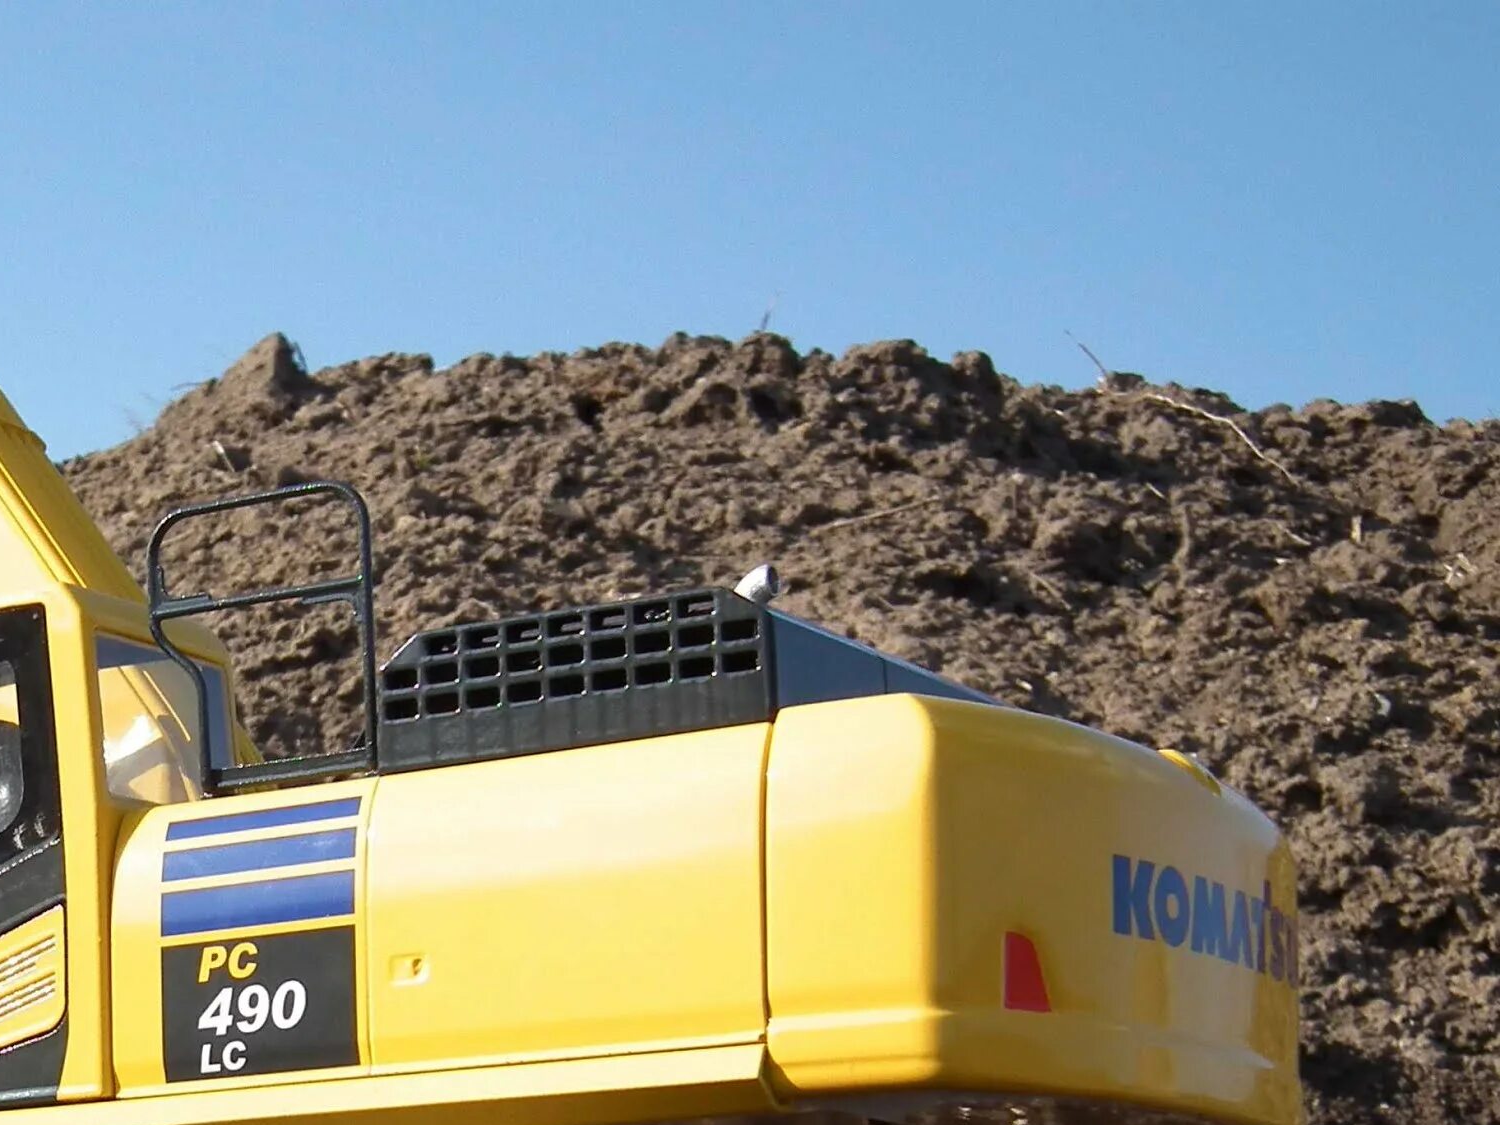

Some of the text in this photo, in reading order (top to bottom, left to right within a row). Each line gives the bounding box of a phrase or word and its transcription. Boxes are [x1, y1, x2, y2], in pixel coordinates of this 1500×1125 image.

[198, 942, 258, 982] PC
[198, 980, 306, 1035] 490
[201, 1041, 246, 1074] LC
